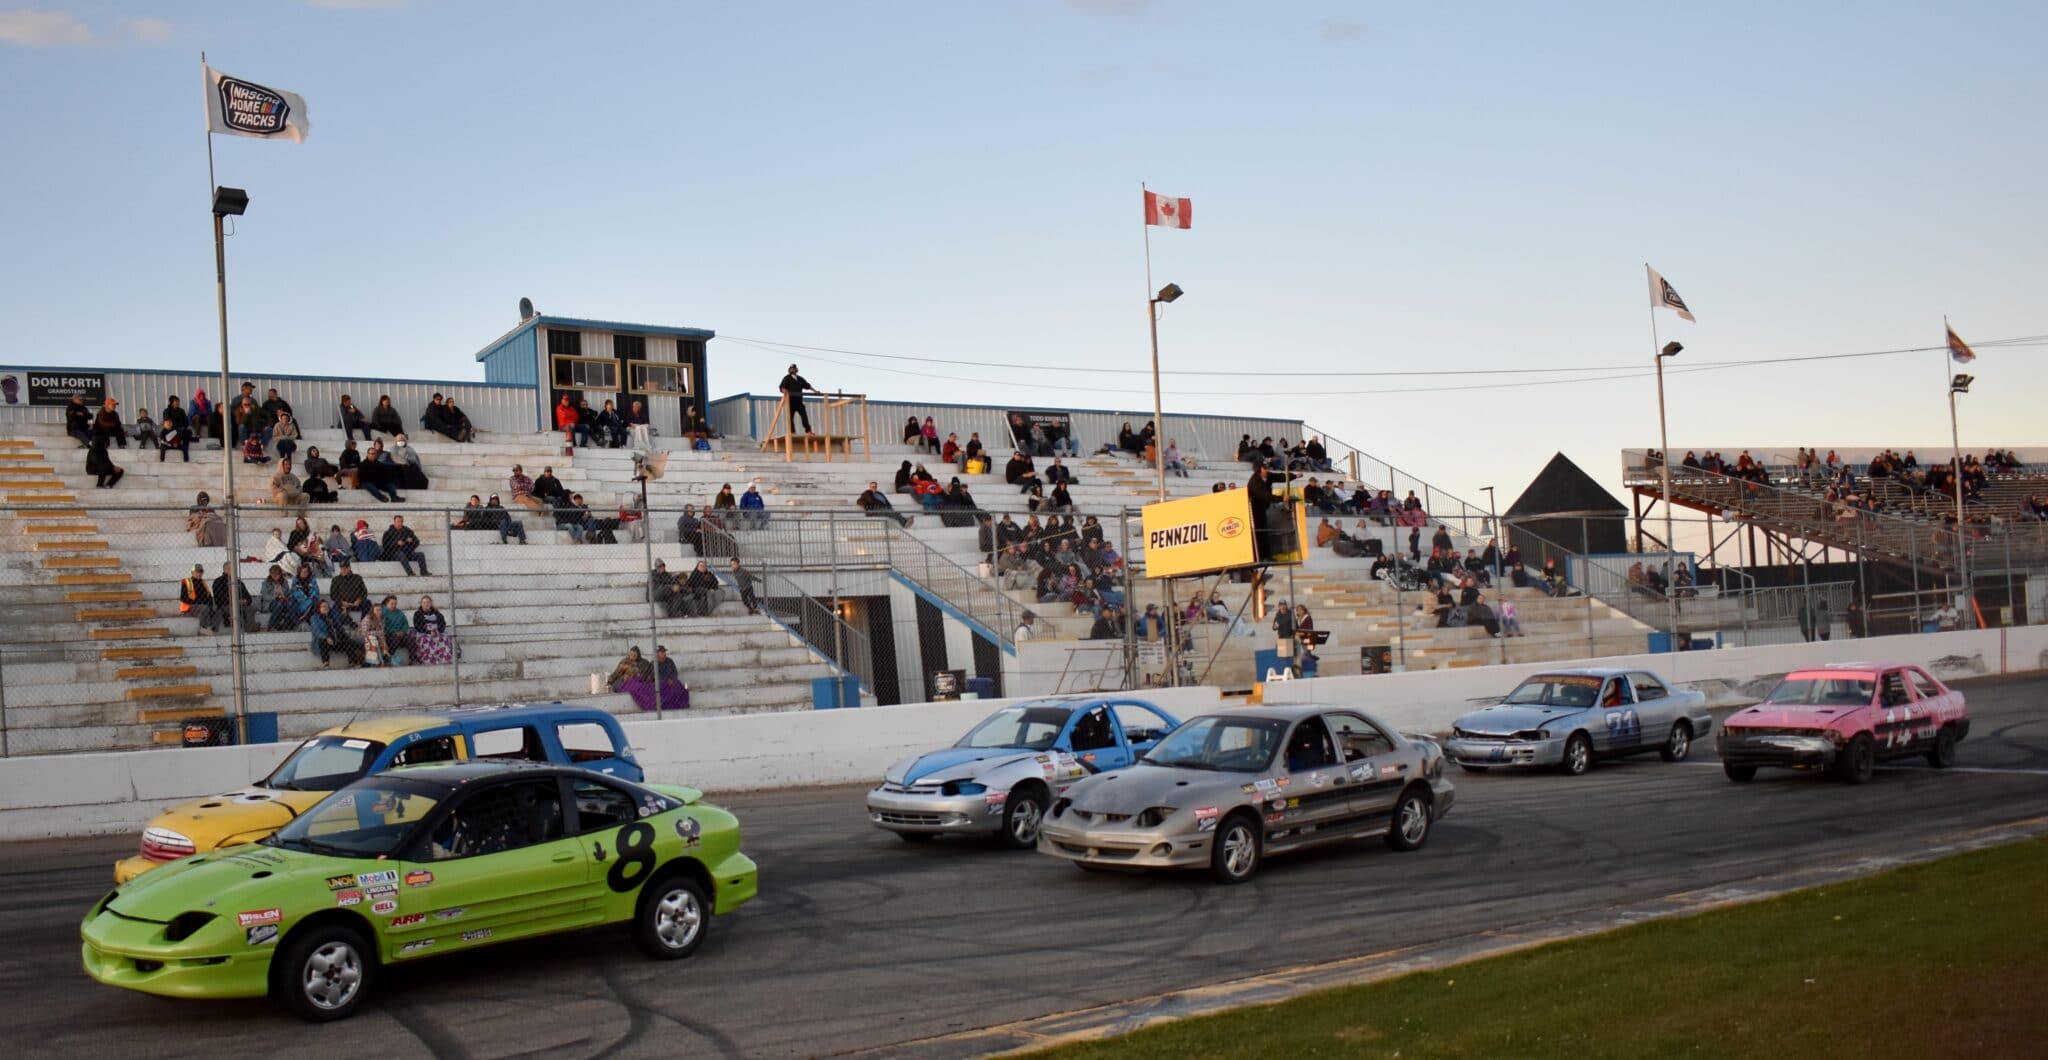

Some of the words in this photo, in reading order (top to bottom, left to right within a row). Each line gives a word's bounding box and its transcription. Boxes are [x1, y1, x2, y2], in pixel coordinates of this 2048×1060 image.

[232, 86, 280, 105] NASCAR
[230, 98, 260, 112] HOME
[233, 112, 276, 127] TRACKS
[31, 377, 59, 387] DON
[61, 377, 101, 388] FORTH
[1151, 523, 1208, 549] PENNZOIL
[607, 822, 656, 893] 8
[360, 873, 385, 884] Mobil
[375, 902, 394, 911] BELL
[391, 913, 425, 926] ARP
